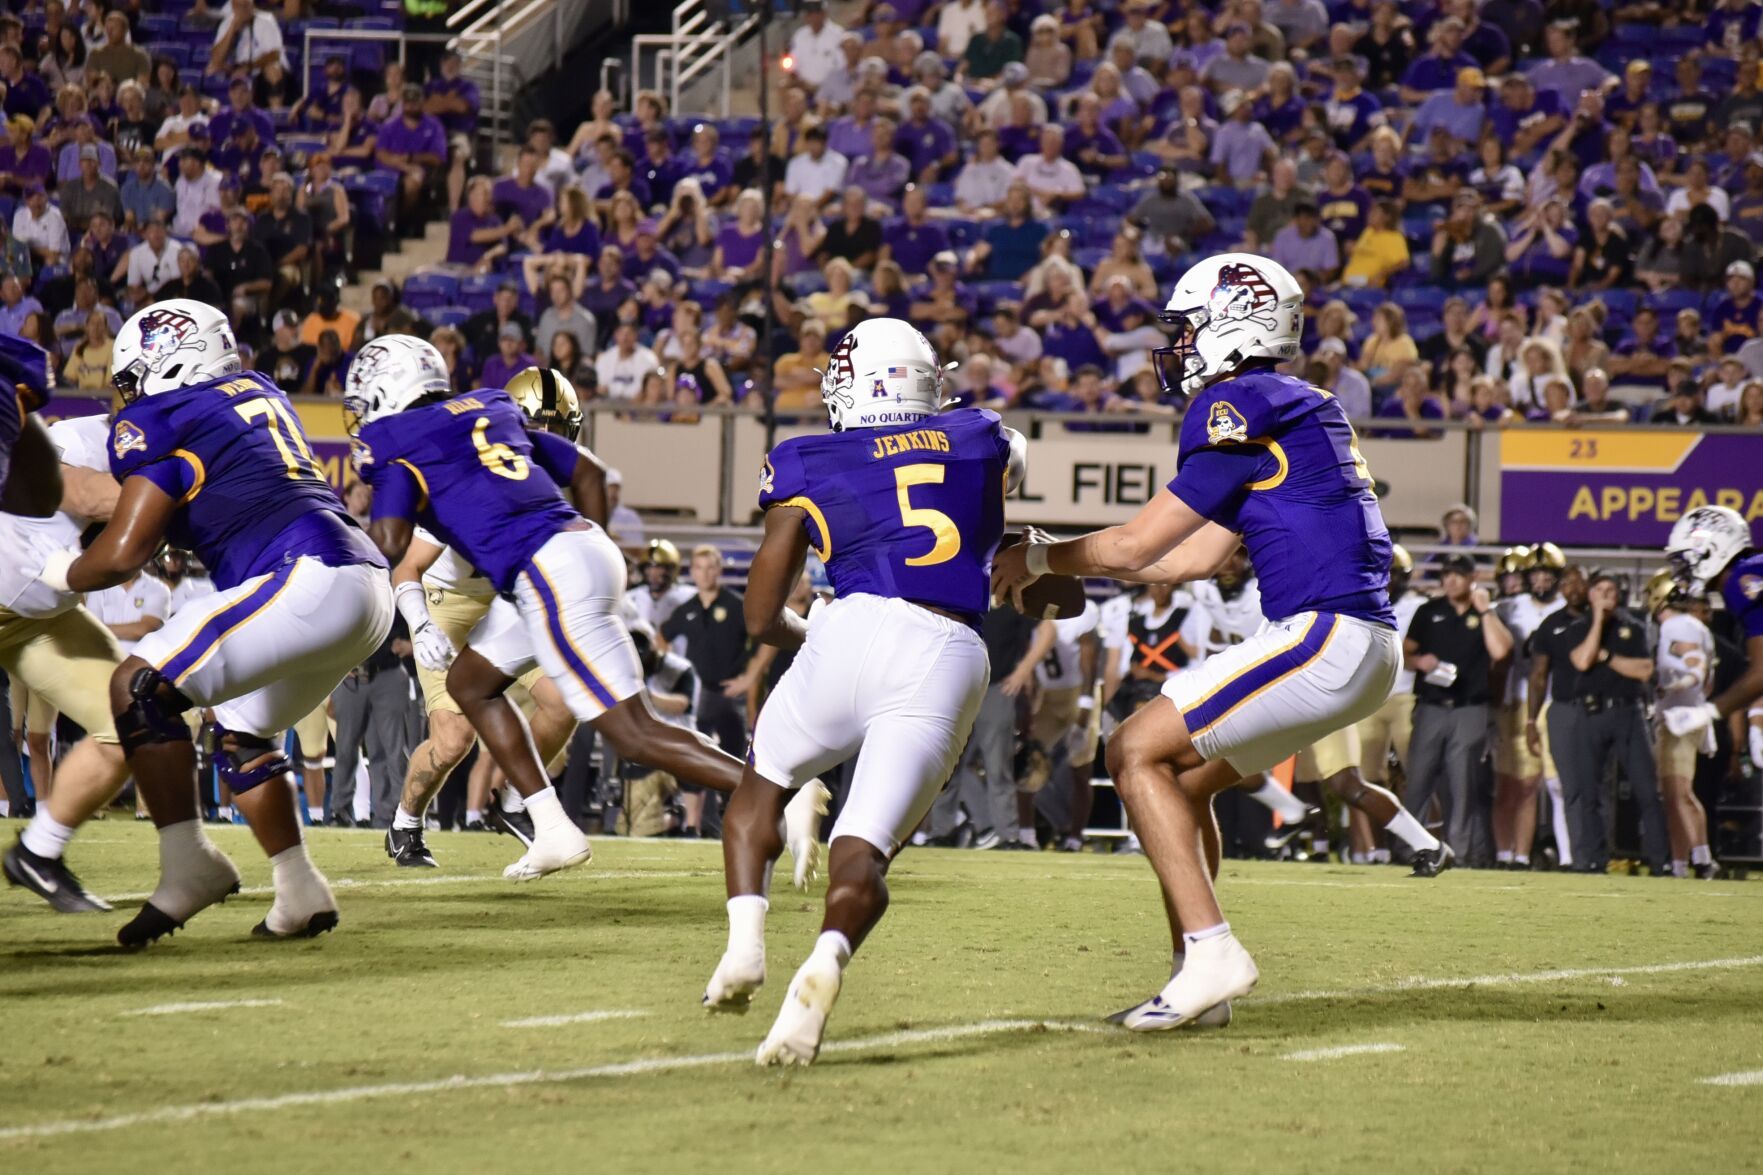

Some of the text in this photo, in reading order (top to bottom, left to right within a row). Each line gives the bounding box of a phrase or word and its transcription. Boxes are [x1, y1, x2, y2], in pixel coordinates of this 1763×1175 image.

[233, 398, 325, 482] 71
[860, 414, 876, 424] NO
[471, 416, 530, 481] 6
[873, 430, 950, 459] JENKINS
[1569, 439, 1598, 459] 23
[894, 463, 961, 566] 5
